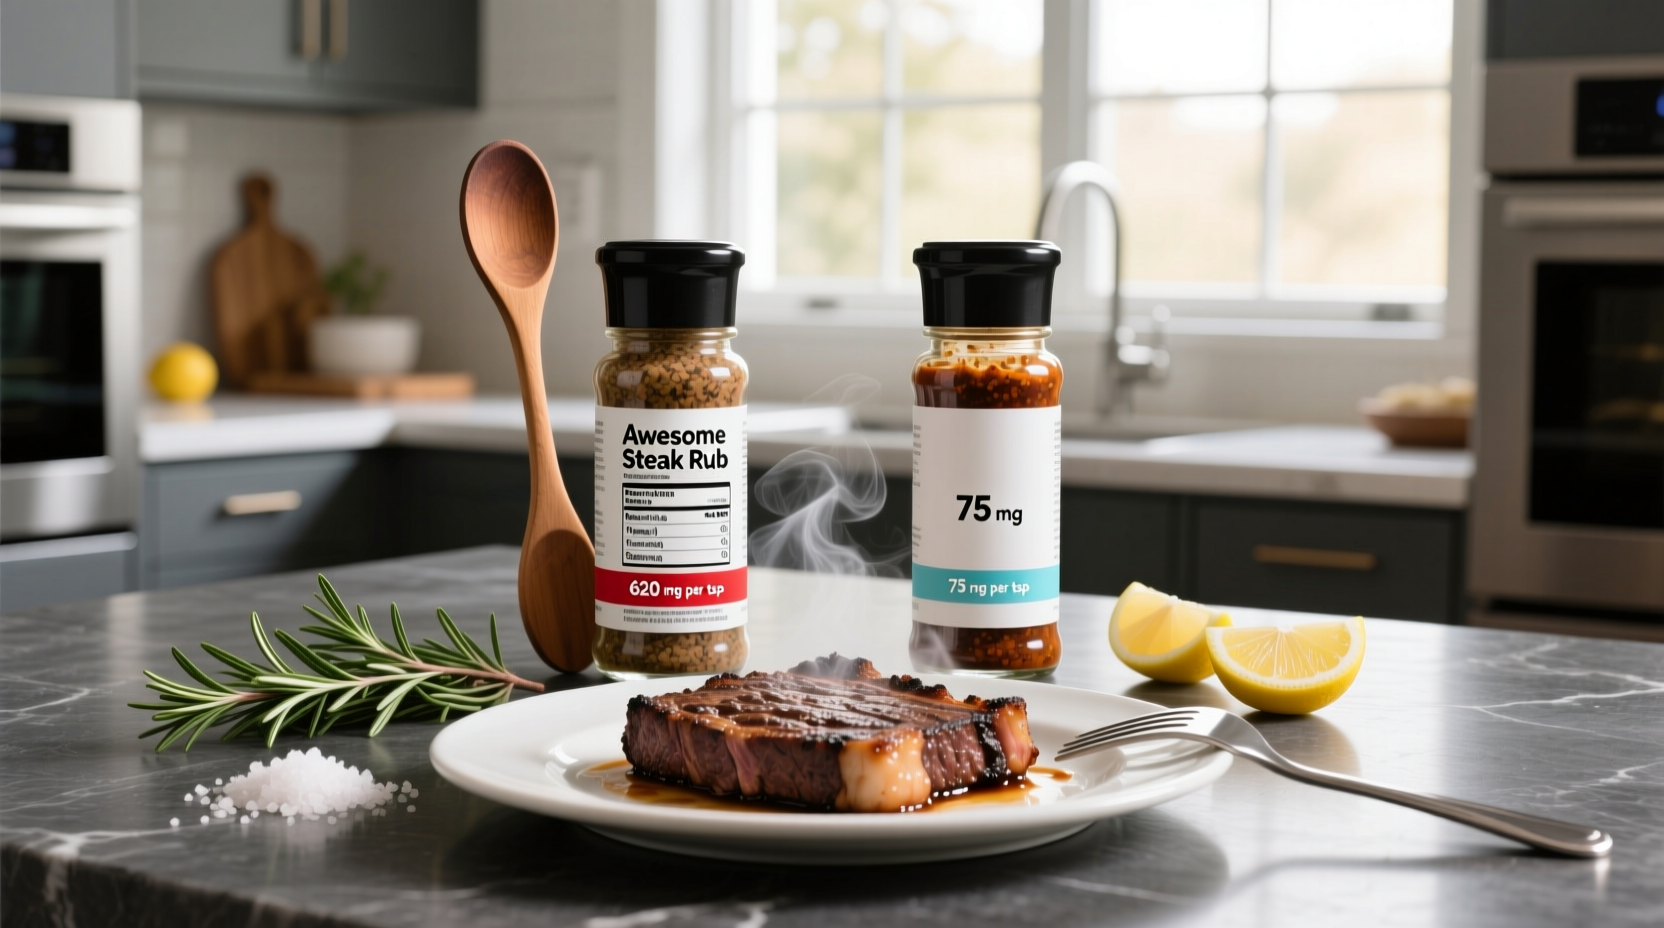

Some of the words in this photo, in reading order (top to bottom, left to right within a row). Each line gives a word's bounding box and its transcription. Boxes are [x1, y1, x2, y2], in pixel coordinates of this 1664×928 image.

[622, 423, 726, 446] Awesome
[622, 448, 684, 470] Steak
[689, 448, 729, 470] Rub
[956, 495, 992, 522] 75
[995, 508, 1023, 526] mg
[629, 580, 661, 597] 620
[685, 586, 704, 600] per
[948, 578, 966, 594] 75
[990, 584, 1009, 598] per
